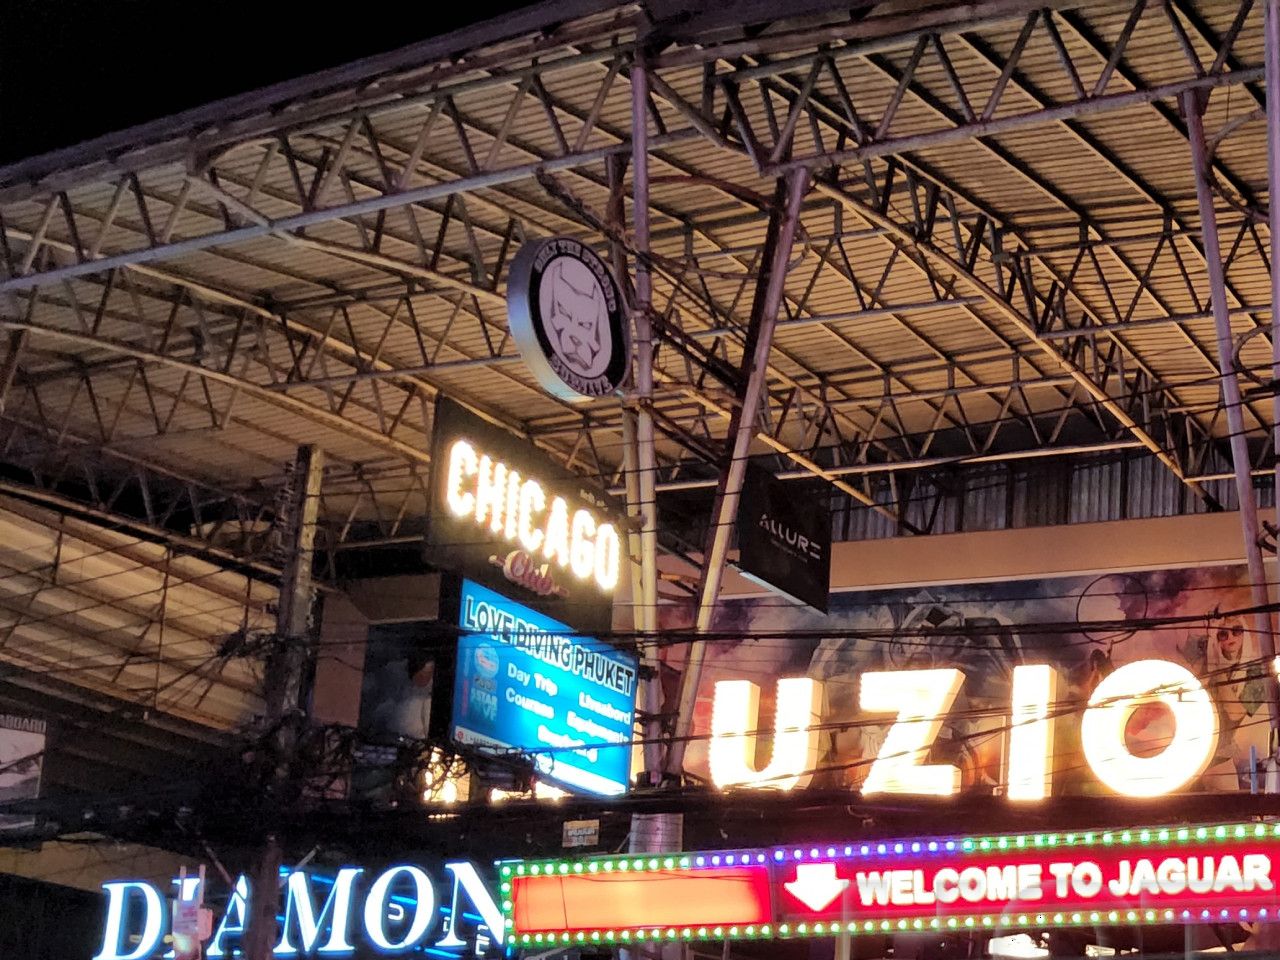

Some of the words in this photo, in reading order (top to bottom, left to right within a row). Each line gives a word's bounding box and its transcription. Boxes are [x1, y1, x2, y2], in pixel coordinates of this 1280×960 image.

[448, 440, 620, 590] CHICAGO
[760, 513, 821, 560] ALLURE
[465, 595, 514, 645] LOVE
[514, 619, 572, 671] DIVING
[573, 645, 636, 697] PHUKET
[507, 662, 530, 687] Day
[856, 864, 1043, 906] WELCOME
[1049, 861, 1103, 898] TO
[1108, 852, 1275, 897] JAGUAR
